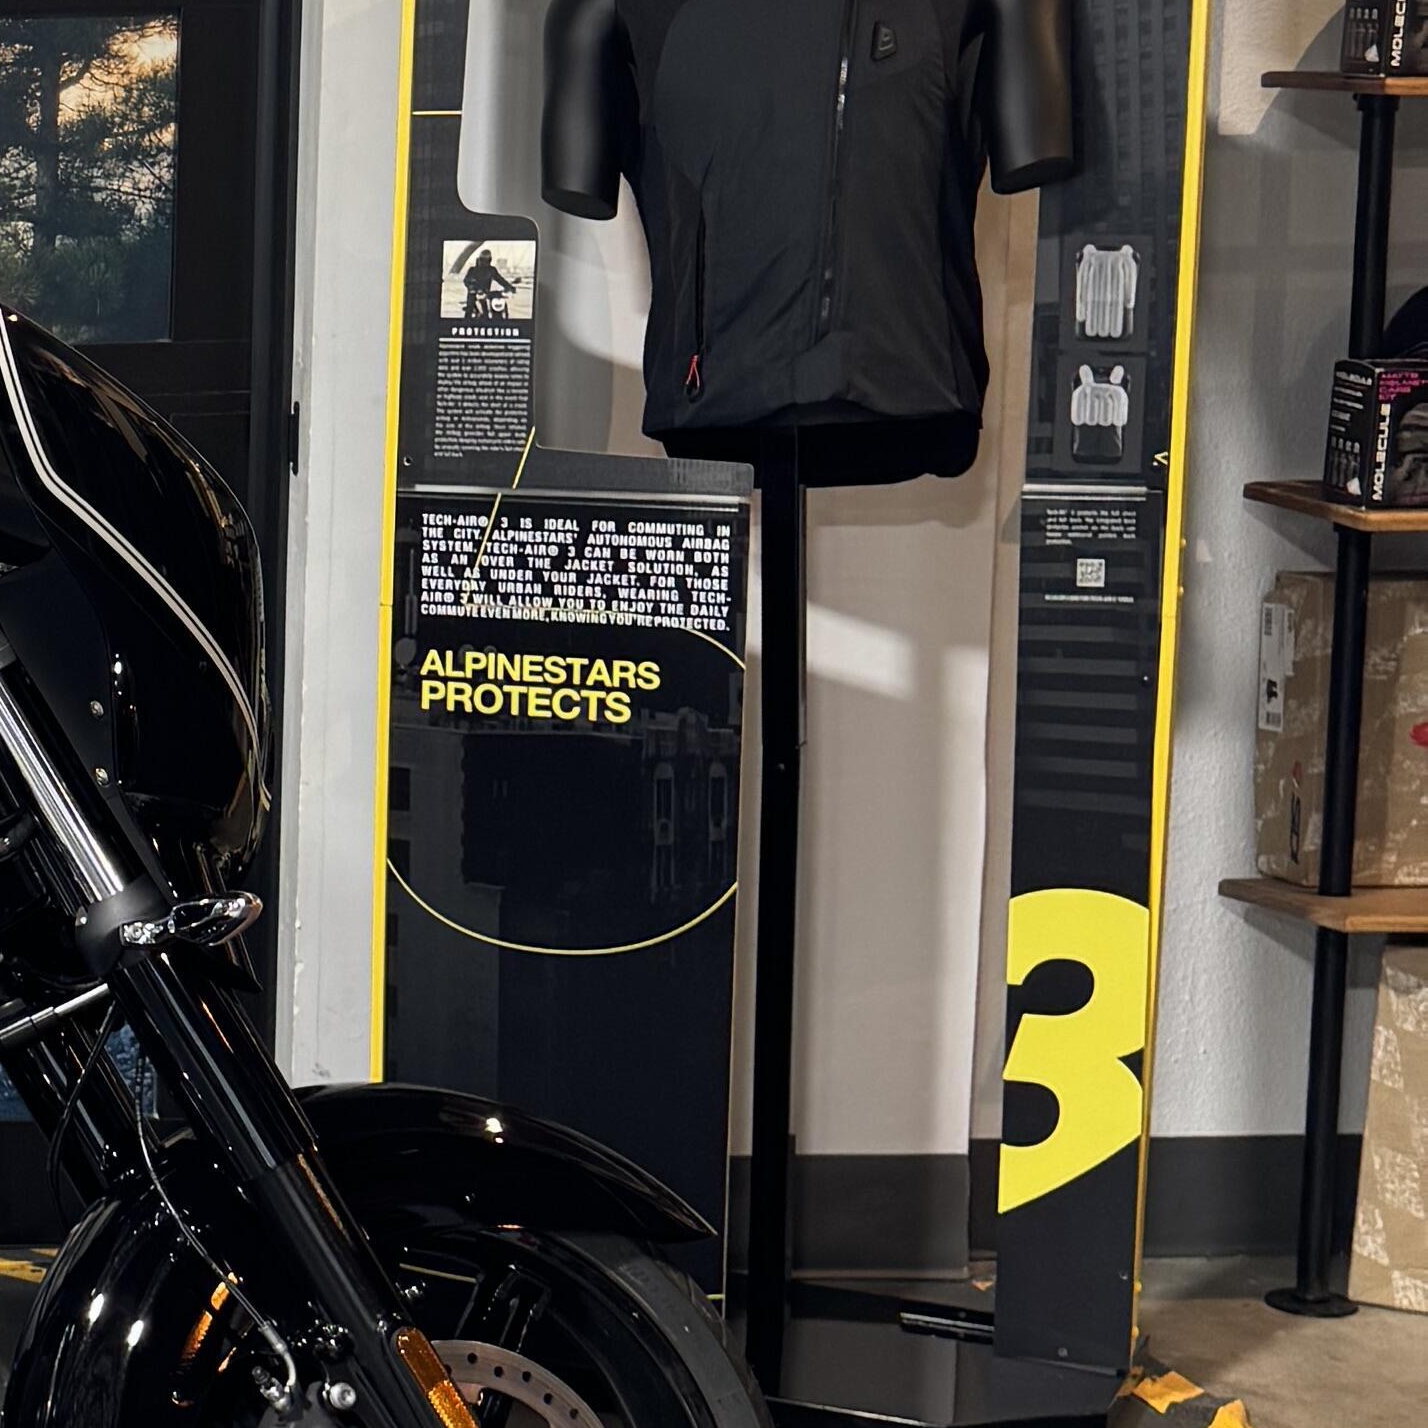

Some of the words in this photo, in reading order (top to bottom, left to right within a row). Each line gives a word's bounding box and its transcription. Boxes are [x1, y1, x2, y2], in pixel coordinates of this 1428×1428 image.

[422, 527, 443, 538] THE
[587, 534, 672, 548] AUTONOMOUS
[682, 538, 730, 550] AIRBAG
[500, 517, 508, 528] 3
[520, 518, 532, 529] IS
[544, 519, 579, 531] IDEAL
[592, 520, 616, 532] FOR
[628, 522, 704, 536] COMMUTING
[716, 525, 730, 537] IN
[421, 553, 438, 564] AS
[451, 554, 468, 565] AN
[481, 555, 514, 567] OVER
[528, 557, 551, 569] THE
[564, 558, 614, 572] JACKET
[711, 566, 729, 577] AS
[567, 546, 576, 557] 3
[584, 547, 611, 559] CAN
[620, 548, 637, 560] BE
[645, 549, 684, 562] WORN
[694, 551, 730, 564] BOTH
[421, 566, 454, 578] WELL
[464, 567, 480, 578] AS
[490, 569, 533, 581] UNDER
[543, 571, 577, 583] YOUR
[650, 576, 675, 588] FOR
[686, 577, 728, 591] THOSE
[421, 578, 486, 591] EVERYDAY
[498, 581, 542, 594] URBAN
[618, 587, 679, 602] WEARING
[691, 591, 731, 603] TECH-
[460, 593, 469, 603] 3
[473, 594, 503, 605] WILL
[509, 595, 552, 607] ALLOW
[558, 598, 584, 610] YOU
[589, 599, 606, 610] TO
[611, 600, 654, 614] ENJOY
[660, 602, 684, 615] THE
[690, 604, 729, 618] DAILY
[420, 649, 661, 690] ALPINESTARS
[421, 679, 632, 723] PROTECTS
[998, 887, 1150, 1215] 3
